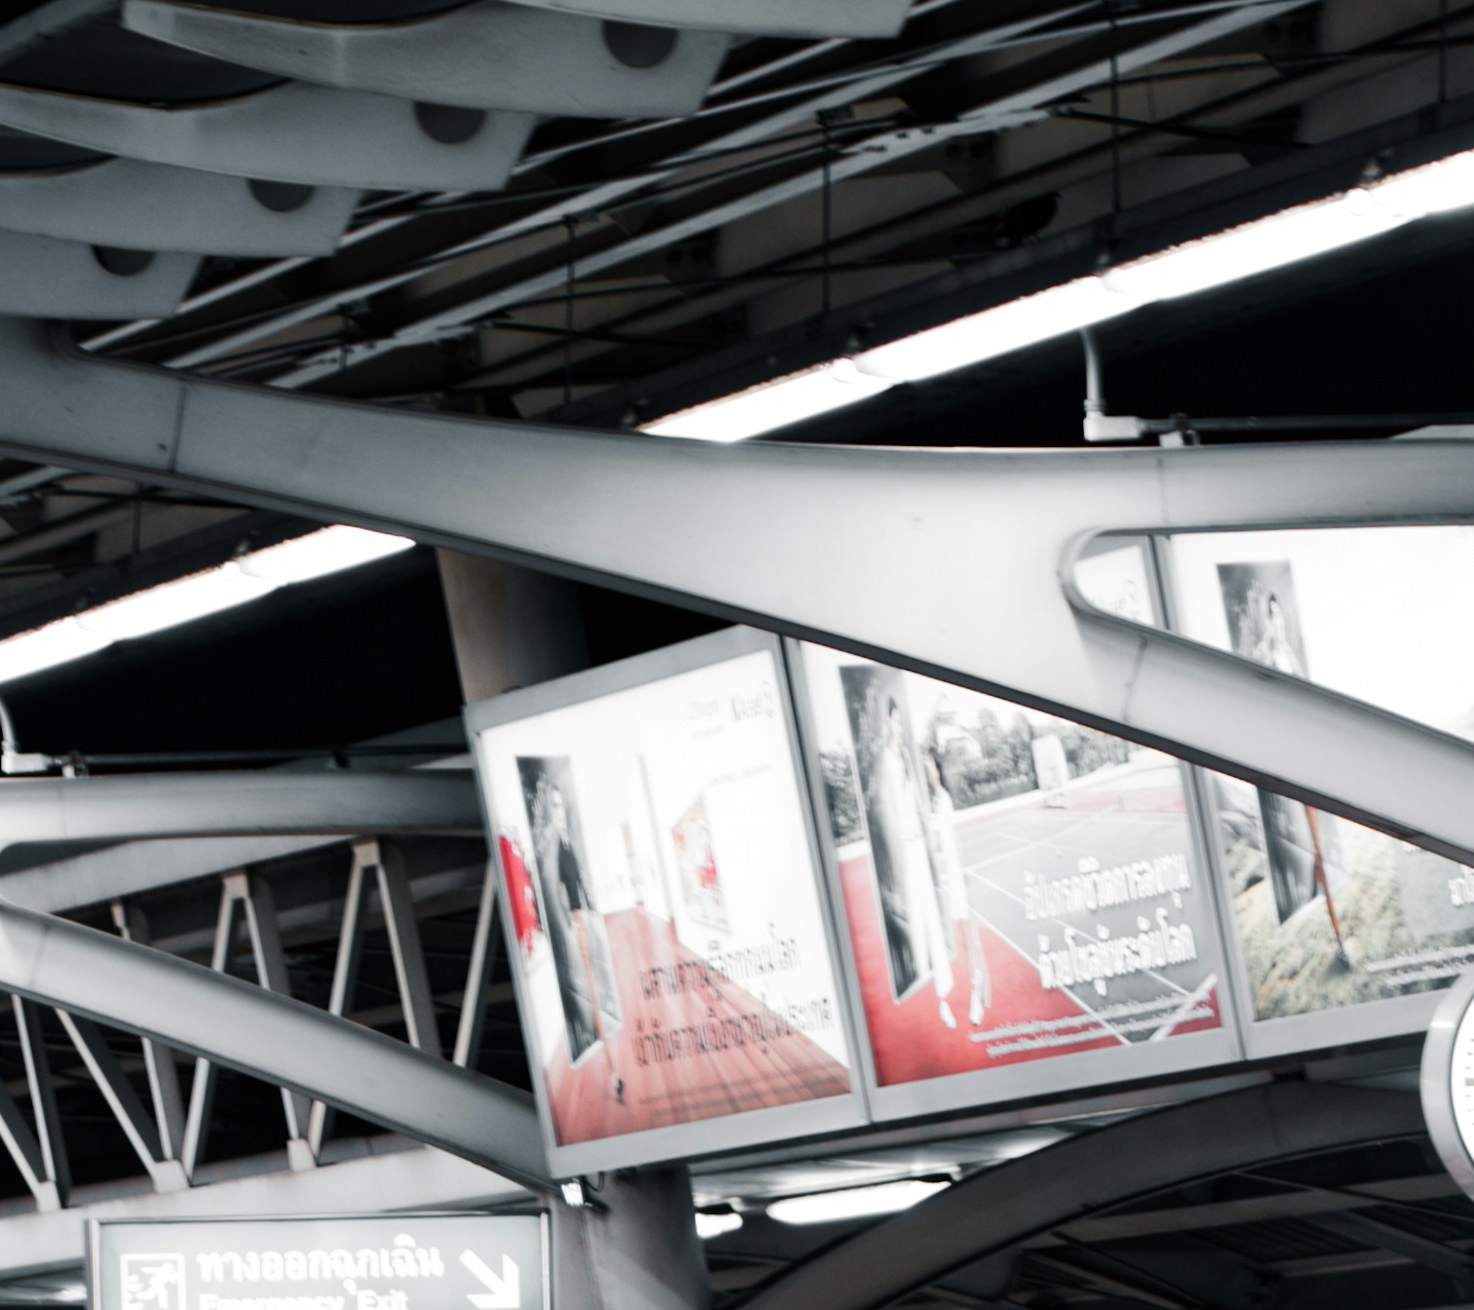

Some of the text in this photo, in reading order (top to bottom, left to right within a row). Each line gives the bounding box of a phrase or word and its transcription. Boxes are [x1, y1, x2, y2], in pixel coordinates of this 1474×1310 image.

[196, 1233, 445, 1295] ทางออกฉุกเฉิน
